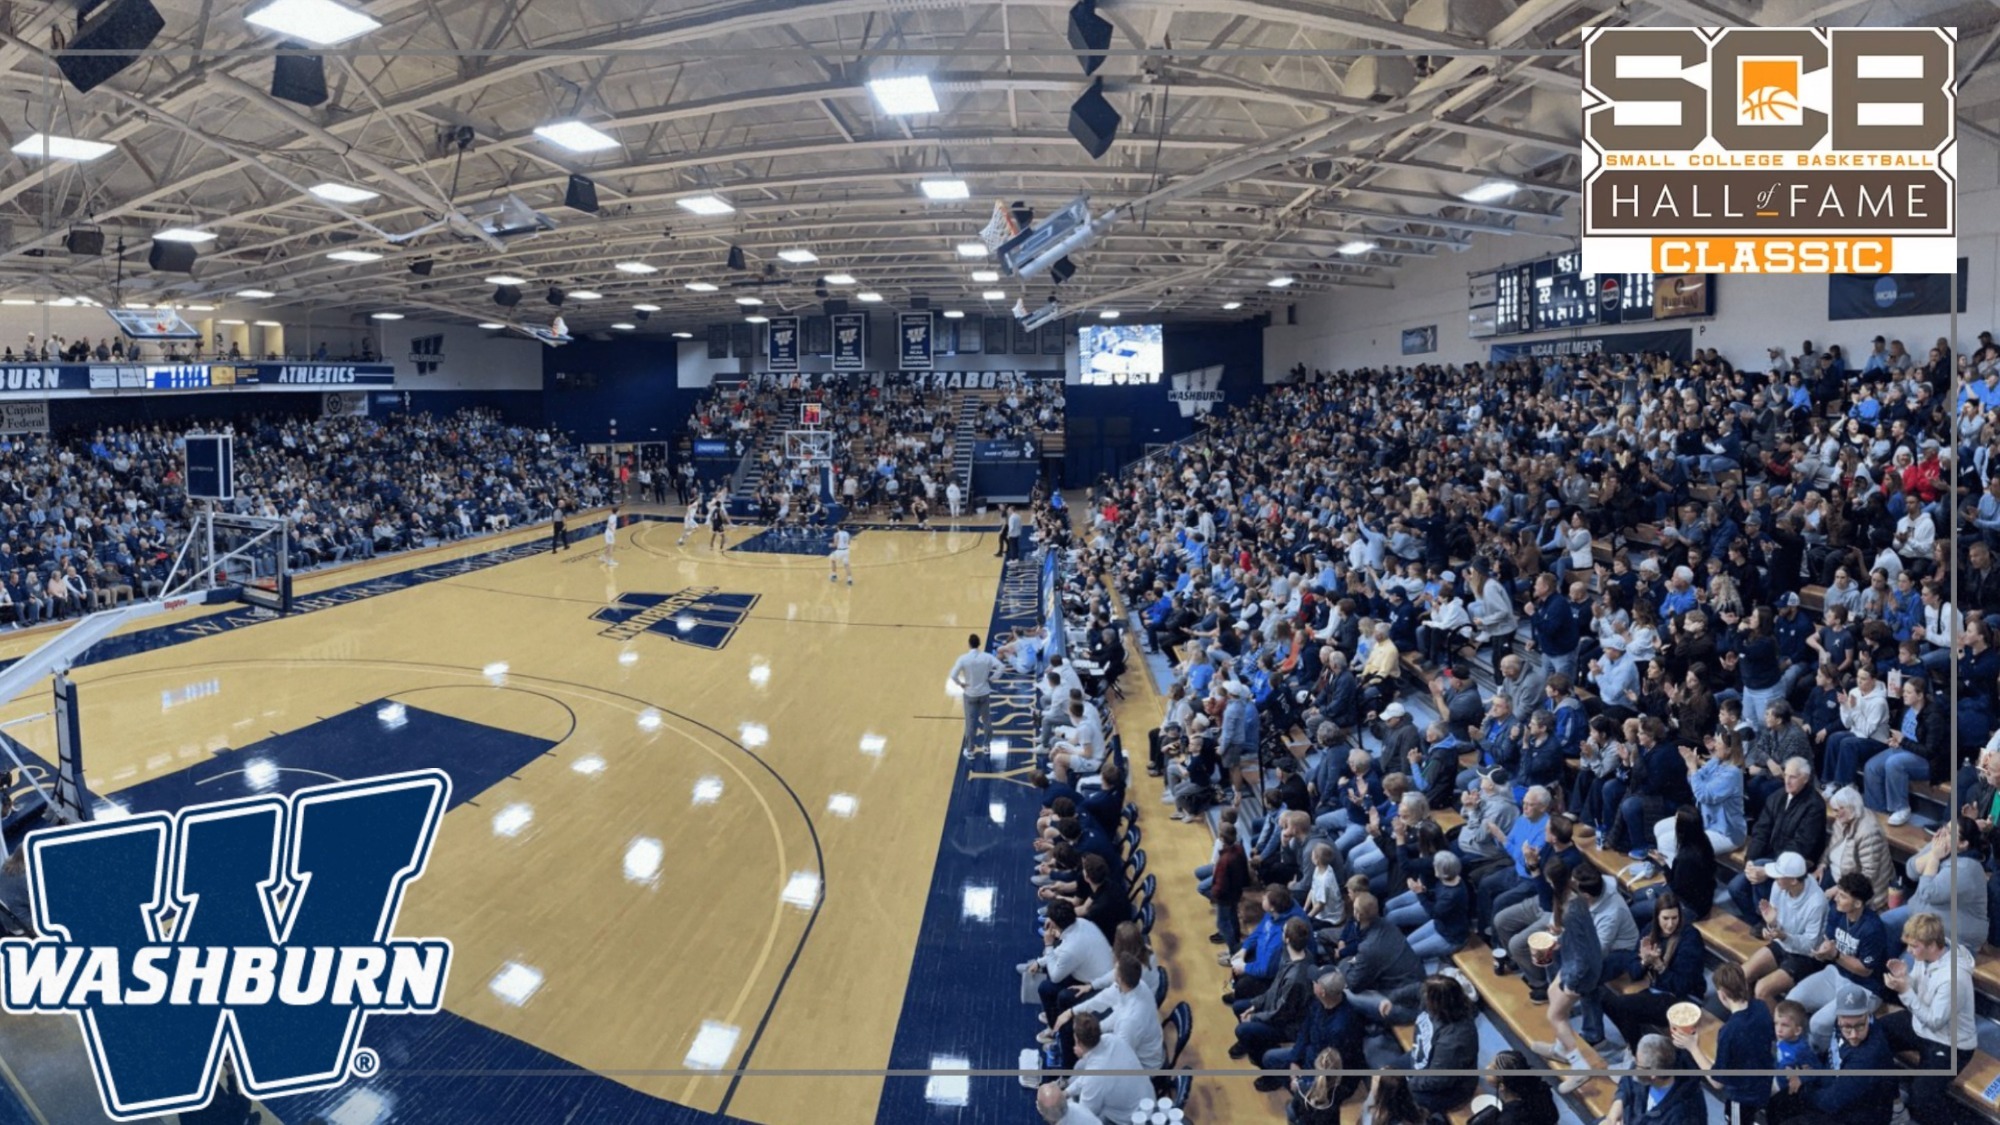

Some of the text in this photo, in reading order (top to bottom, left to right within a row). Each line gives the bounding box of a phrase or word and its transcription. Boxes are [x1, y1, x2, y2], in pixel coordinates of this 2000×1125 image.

[1530, 344, 1553, 356] NCAA
[1572, 340, 1603, 354] MEN'S
[0, 368, 60, 390] URN
[278, 365, 356, 383] ATHLETICS
[1168, 391, 1224, 401] WASHBURN
[6, 402, 44, 416] Capitol
[7, 418, 46, 428] Federal
[597, 586, 719, 640] WASHBURN
